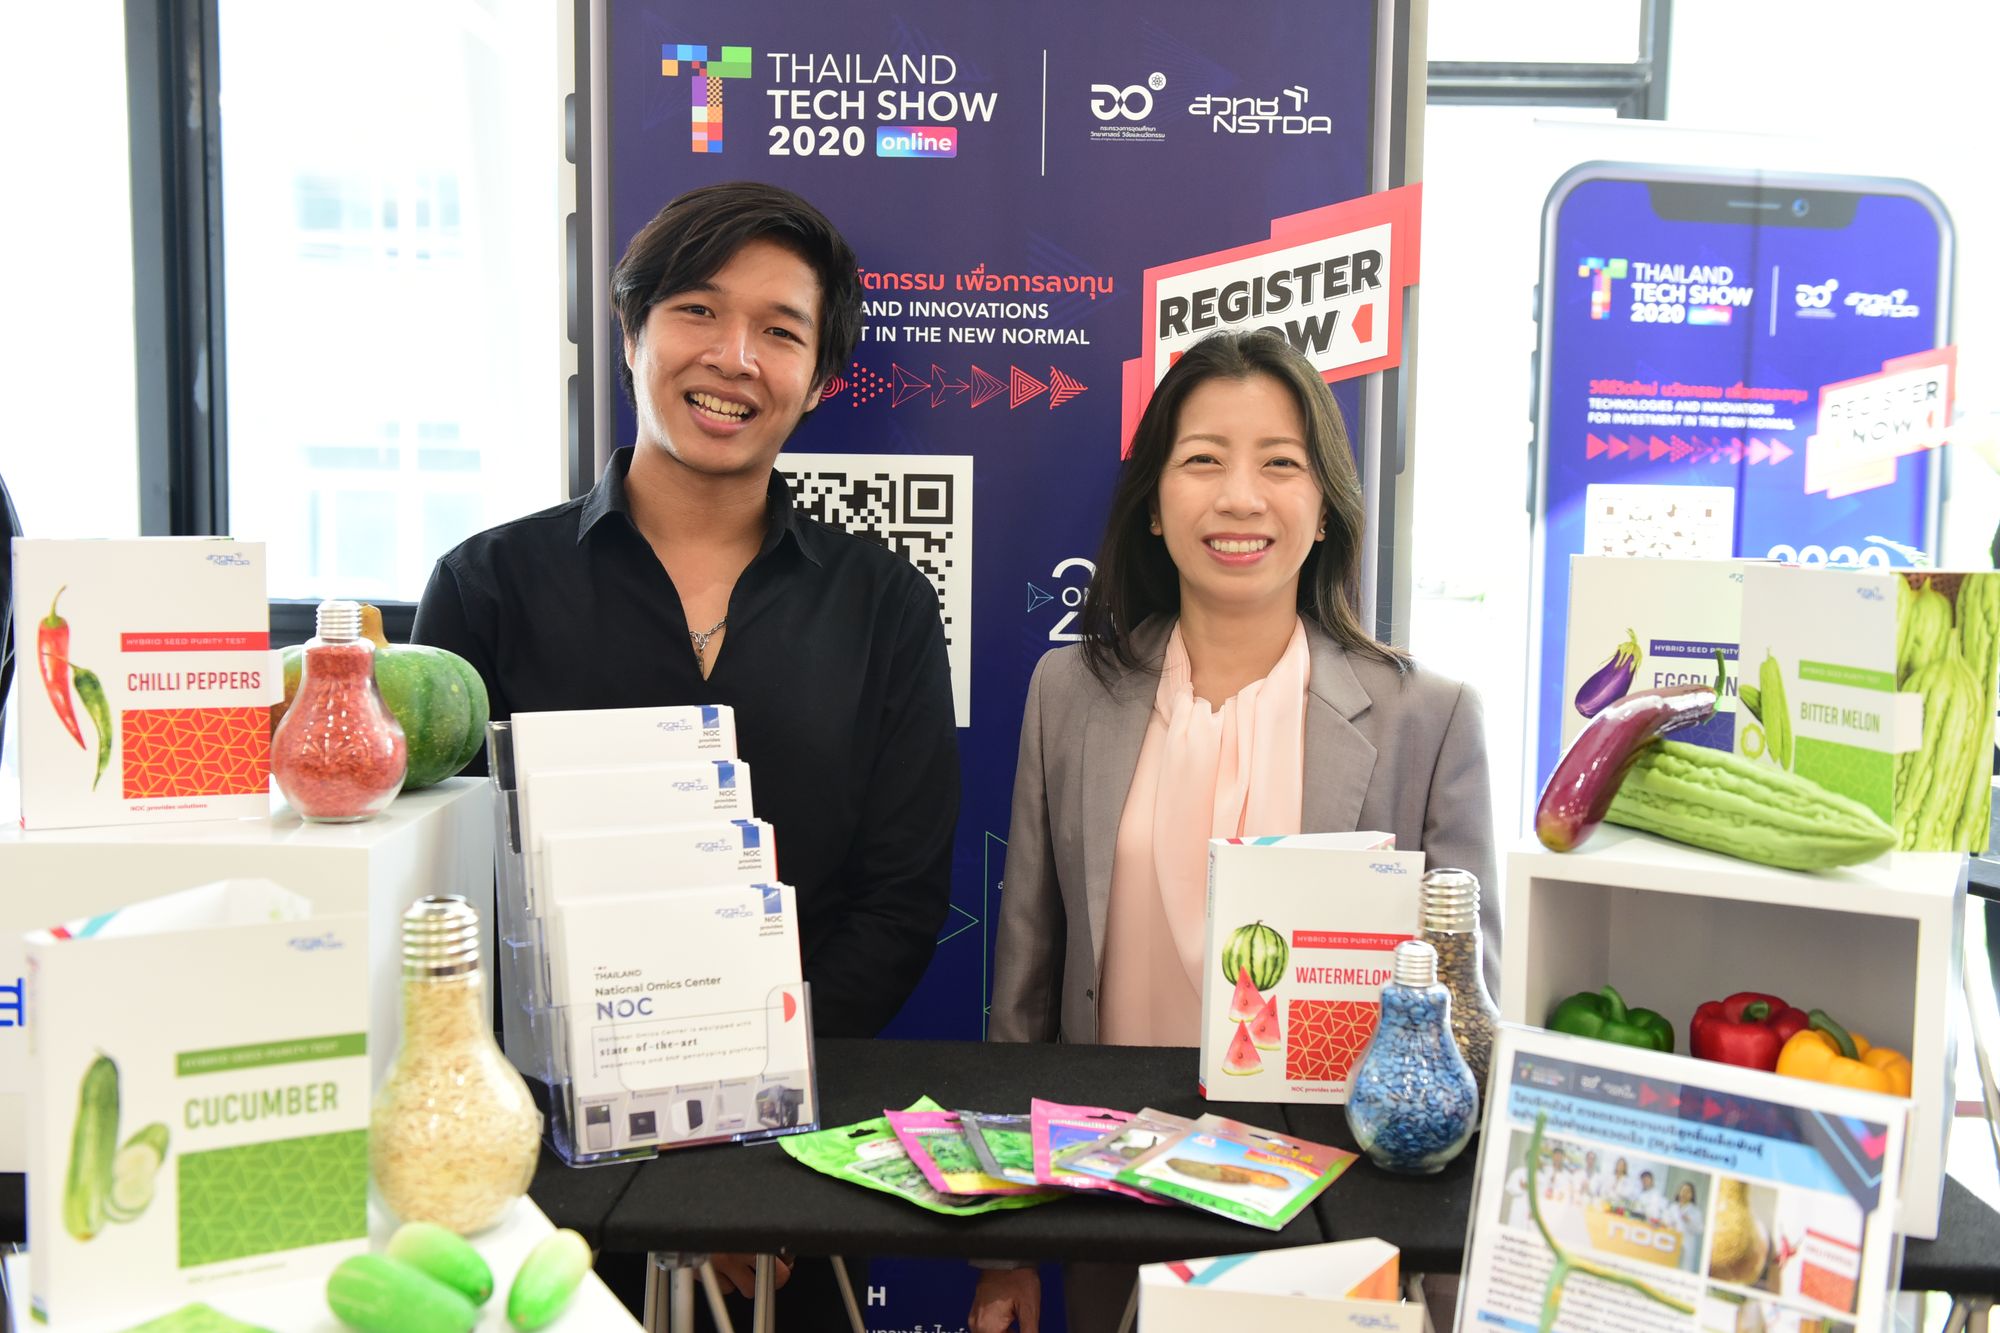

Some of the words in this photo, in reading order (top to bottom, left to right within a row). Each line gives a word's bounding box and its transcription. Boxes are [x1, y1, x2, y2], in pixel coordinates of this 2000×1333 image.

[767, 53, 957, 84] THAILAND
[767, 90, 865, 120] TECH
[877, 91, 997, 122] SHOW
[1213, 116, 1332, 134] NSTDA
[769, 126, 865, 156] 2020
[881, 132, 952, 151] online
[956, 263, 1113, 300] เพื่อการลงทุน
[1632, 262, 1733, 285] THAILAND
[1159, 249, 1384, 341] REGISTER
[1631, 282, 1686, 303] TECH
[1688, 284, 1753, 306] SHOW
[860, 301, 902, 316] AND
[909, 301, 1049, 319] INNOVATIONS
[1630, 302, 1685, 323] 2020
[876, 326, 896, 342] IN
[903, 327, 941, 343] THE
[949, 328, 996, 344] NEW
[1002, 329, 1090, 345] NORMAL
[1588, 397, 1674, 413] TECHNOLOGIES
[1674, 400, 1701, 414] AND
[1702, 400, 1775, 416] INNOVATIONS
[1831, 381, 1938, 419] REGSTER
[1587, 411, 1611, 424] FOR
[1611, 412, 1682, 426] INVESTMENT
[1683, 414, 1698, 427] IN
[1699, 415, 1719, 428] THE
[1720, 416, 1746, 429] NEW
[1746, 417, 1795, 431] NORMAL
[1654, 645, 1685, 653] HYBRID
[1687, 646, 1708, 654] SEED
[128, 673, 180, 692] CHILLI
[187, 671, 261, 690] PEPPERS
[1801, 701, 1838, 726] BITTER
[1842, 707, 1880, 733] MELON
[765, 915, 783, 923] NOC
[594, 969, 642, 980] THAILAND
[1295, 967, 1392, 986] WATERMELON
[595, 984, 643, 997] National
[647, 981, 682, 992] Omics
[684, 977, 722, 988] Center
[596, 997, 653, 1021] NOC
[184, 1081, 338, 1130] CUCUMBER
